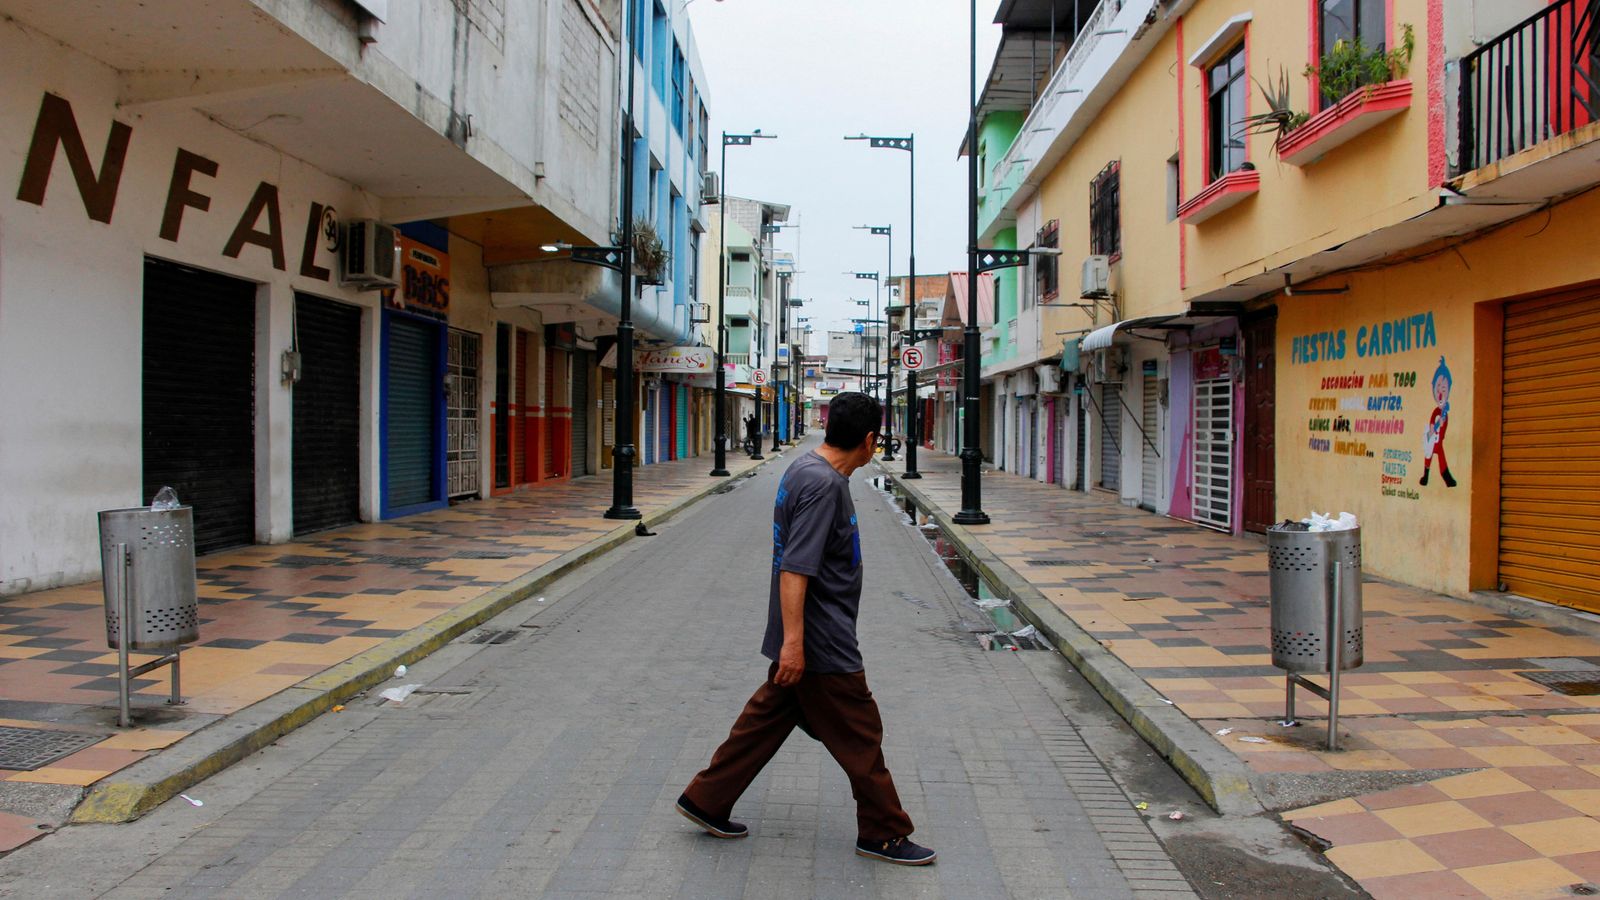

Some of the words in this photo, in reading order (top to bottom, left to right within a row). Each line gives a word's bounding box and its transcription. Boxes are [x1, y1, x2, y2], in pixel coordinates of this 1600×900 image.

[1292, 329, 1347, 365] FIESTAS
[1356, 311, 1436, 358] CARMITA
[1368, 373, 1388, 389] PARA
[1393, 371, 1416, 388] TODO
